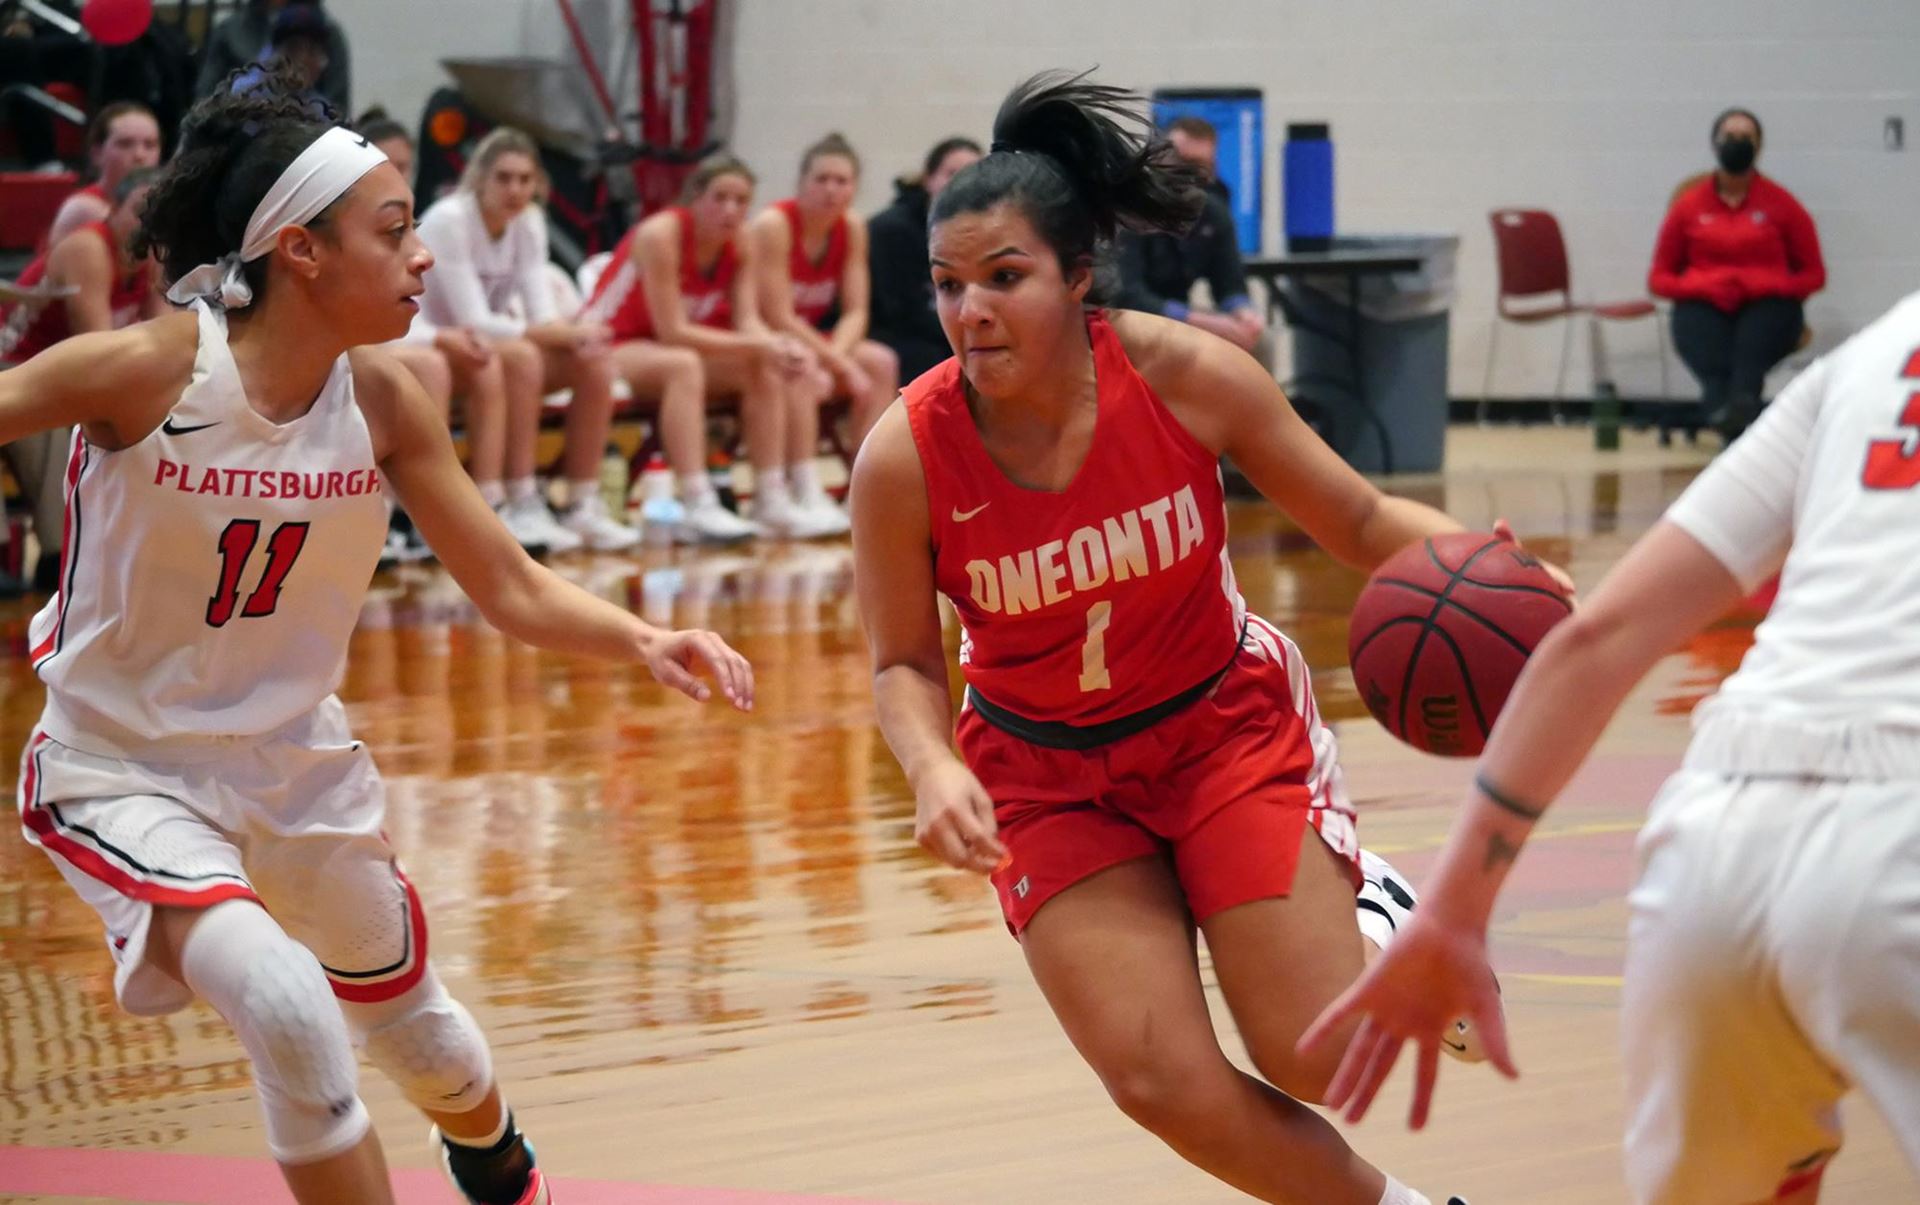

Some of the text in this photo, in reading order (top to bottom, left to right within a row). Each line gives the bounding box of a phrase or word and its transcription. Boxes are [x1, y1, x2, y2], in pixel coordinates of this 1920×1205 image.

[205, 518, 311, 628] 11
[965, 483, 1204, 616] ONEONTA
[1079, 600, 1112, 692] 1
